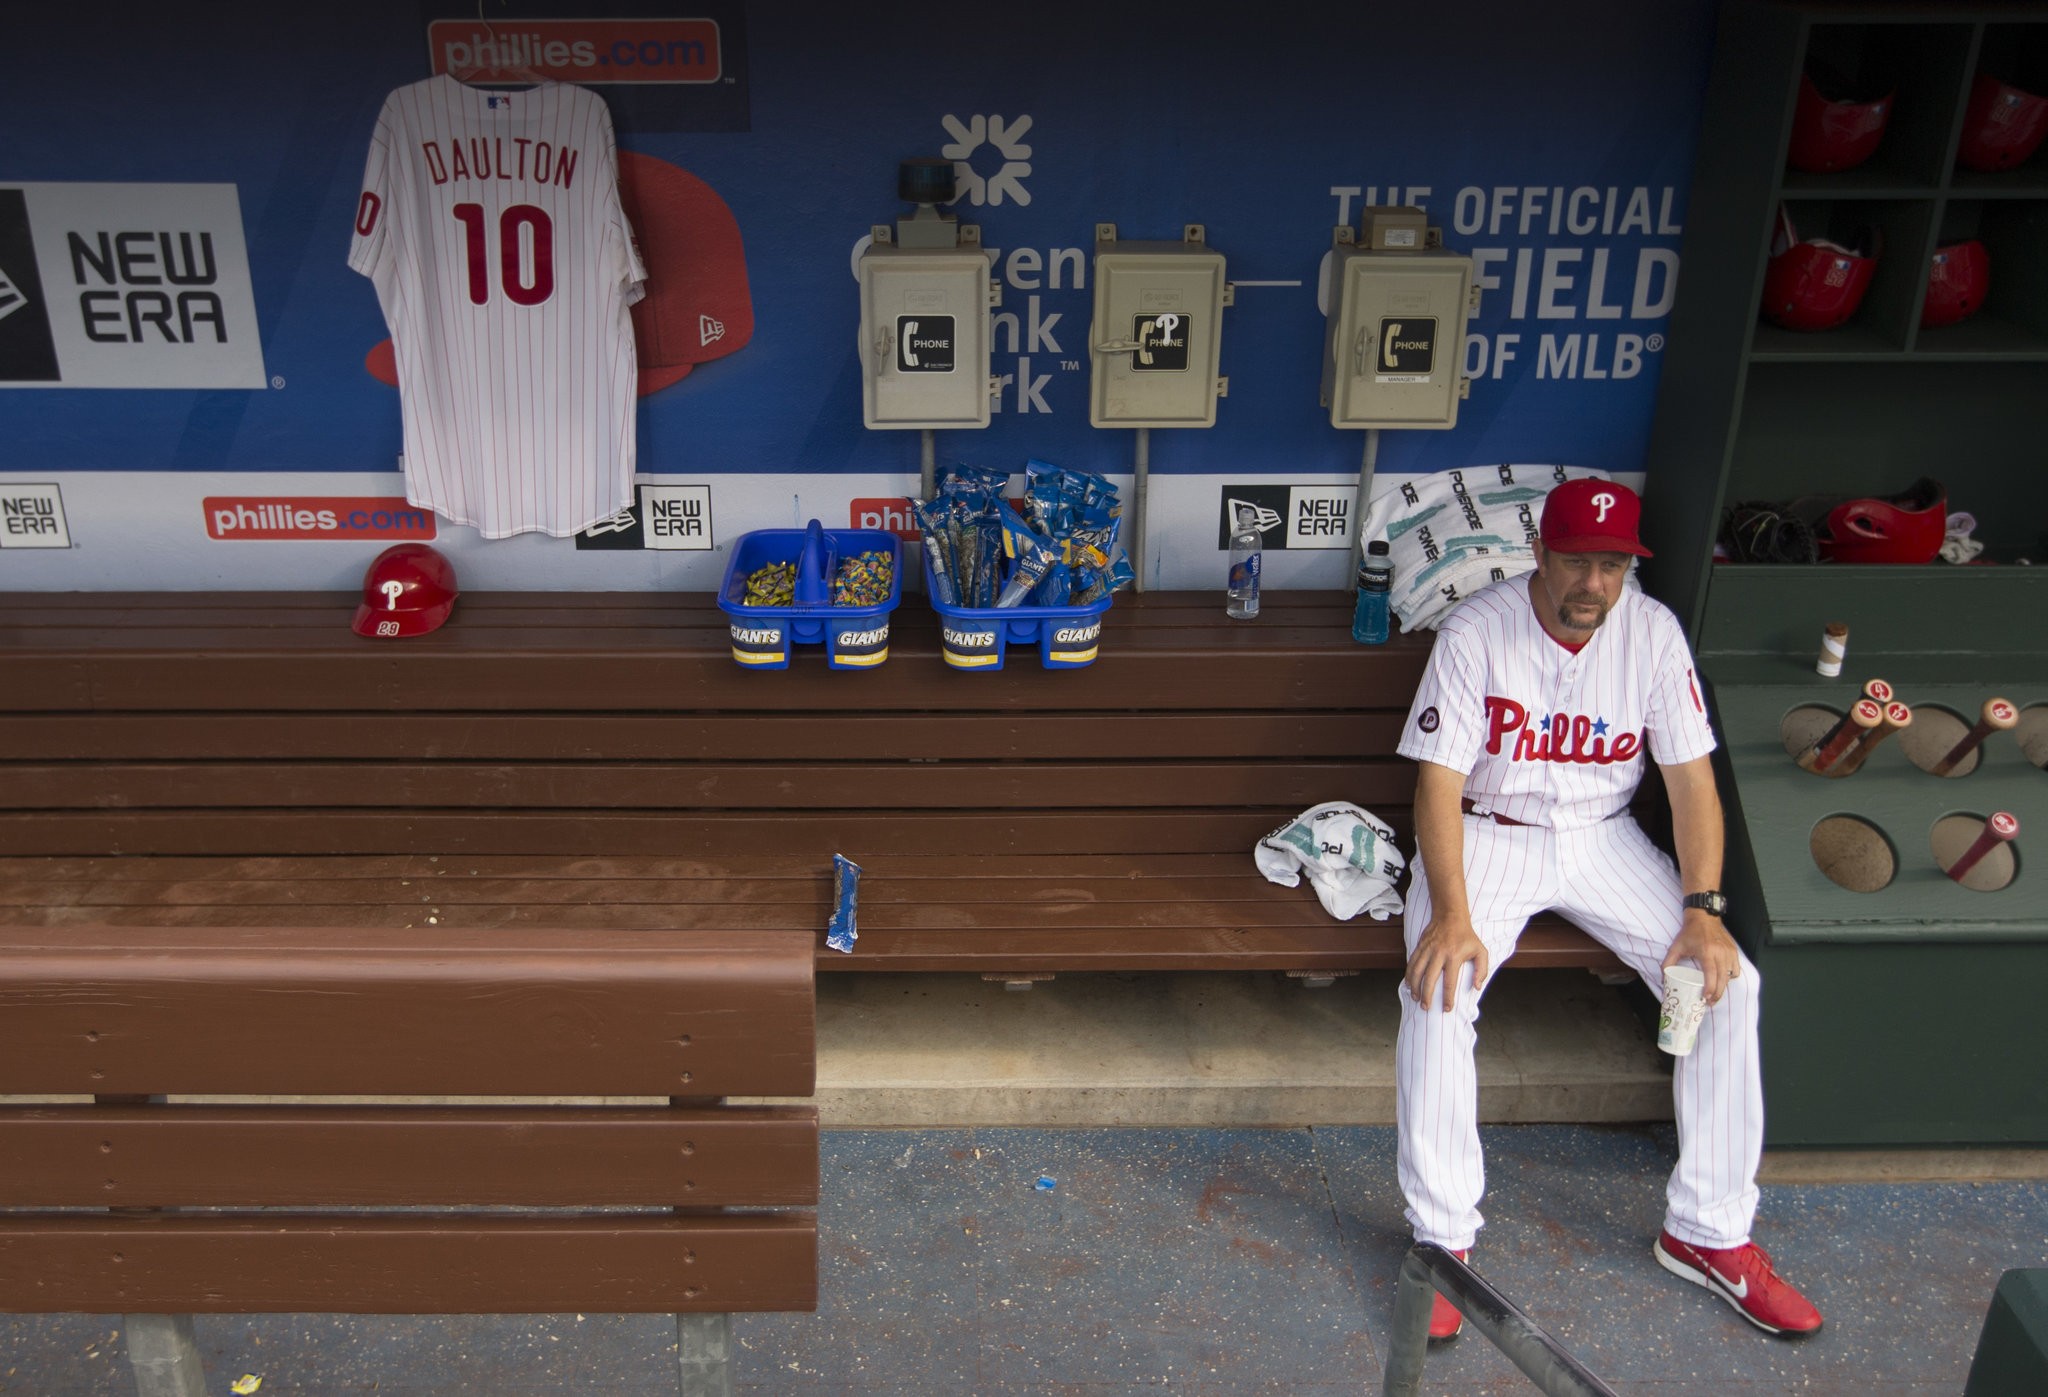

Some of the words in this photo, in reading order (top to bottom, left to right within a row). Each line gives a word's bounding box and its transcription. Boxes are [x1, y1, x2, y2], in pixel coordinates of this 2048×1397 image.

[445, 34, 706, 73] phillies.com
[422, 138, 578, 190] DAULTON
[1452, 186, 1683, 236] OFFICIAL
[67, 231, 218, 286] NEW
[453, 202, 555, 307] 10
[80, 290, 229, 343] ERA
[913, 339, 950, 349] PHONE
[1149, 338, 1184, 347] PHNE
[1394, 341, 1429, 350] PHONE
[1465, 333, 1520, 380] OF
[2, 498, 54, 515] NEW
[652, 499, 701, 518] NEW
[1299, 499, 1348, 518] NEW
[1591, 492, 1615, 523] P
[7, 517, 58, 534] ERA
[214, 504, 426, 536] phillies.com
[653, 518, 702, 537] ERA
[1298, 518, 1346, 536] ERA
[381, 580, 404, 611] P
[377, 621, 400, 636] 29
[731, 624, 781, 645] GIANTS
[838, 624, 889, 646] GIANTS
[943, 627, 995, 647] GIANTS
[1484, 695, 1646, 765] Phillie
